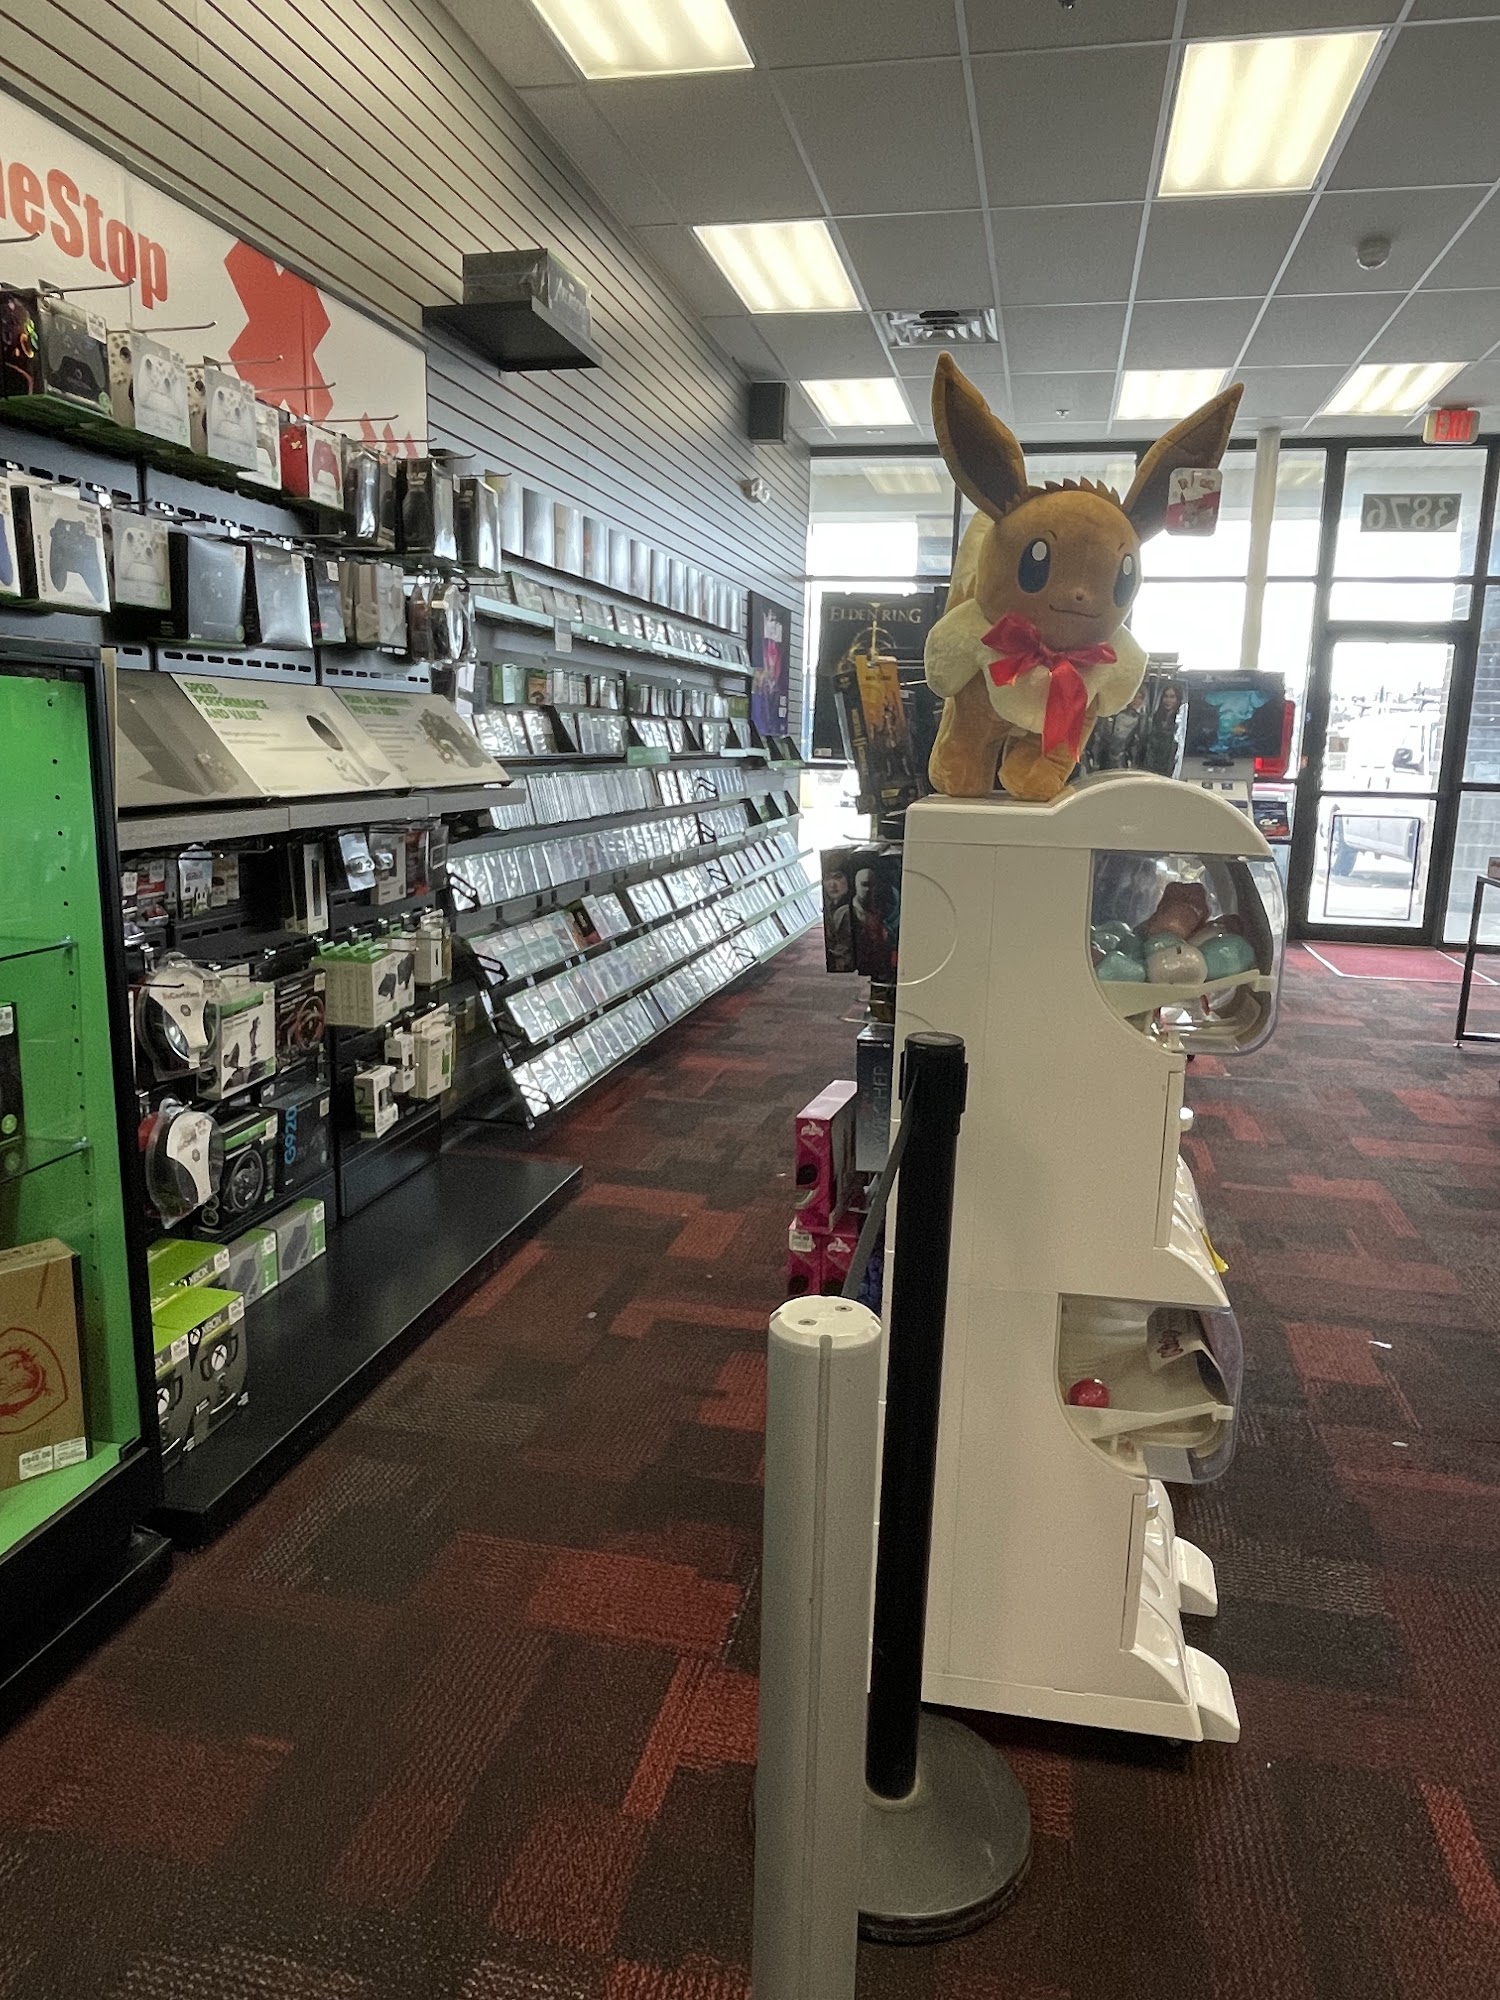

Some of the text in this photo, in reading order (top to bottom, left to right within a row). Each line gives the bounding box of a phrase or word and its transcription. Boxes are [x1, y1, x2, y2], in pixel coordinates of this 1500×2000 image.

[0, 155, 168, 310] eStop
[1435, 411, 1473, 441] EXIT
[829, 606, 922, 624] ELDEN RING
[204, 707, 231, 720] AND
[284, 1104, 298, 1165] G920
[201, 1313, 222, 1334] XBOX
